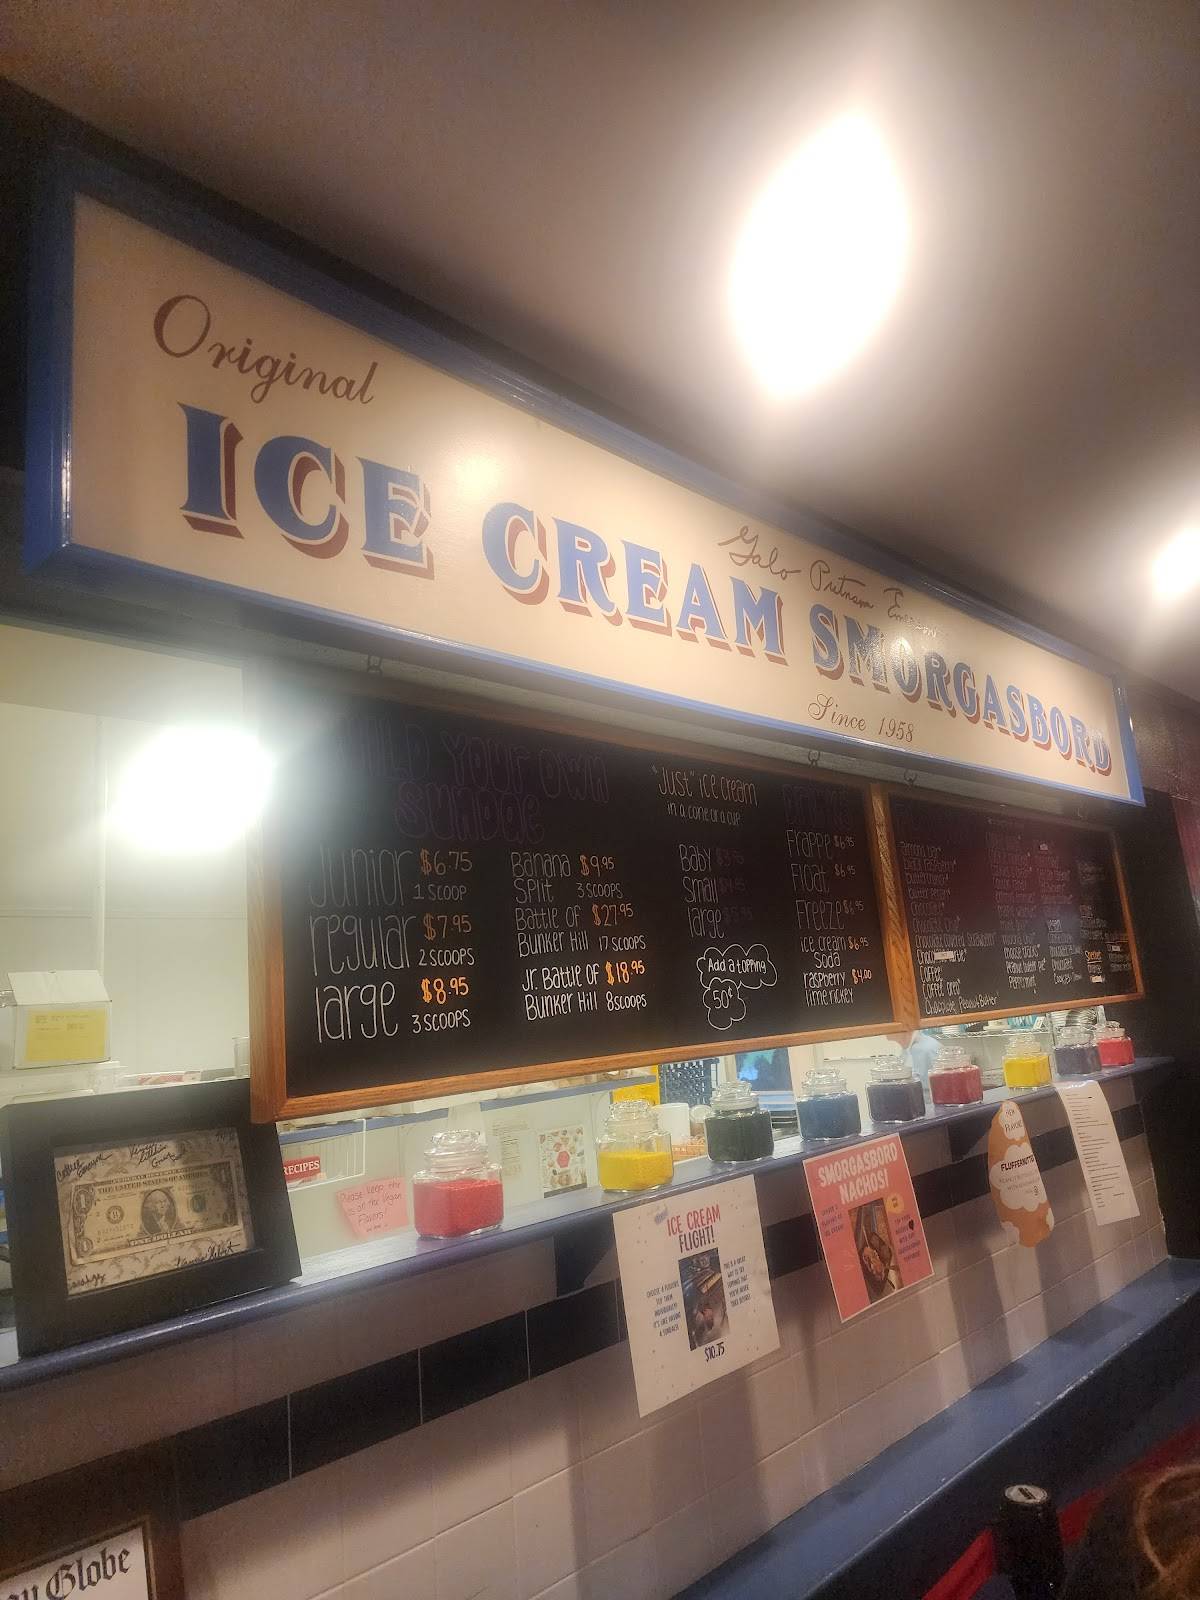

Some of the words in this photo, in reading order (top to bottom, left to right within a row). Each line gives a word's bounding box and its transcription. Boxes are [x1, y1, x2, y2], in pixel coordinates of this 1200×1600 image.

[153, 294, 378, 404] Original
[177, 401, 436, 580] ICE
[482, 501, 789, 666] CREAM
[808, 603, 1112, 777] SMORGASBORD
[807, 693, 867, 732] Since
[877, 716, 915, 743] 1958
[700, 774, 719, 799] ice
[720, 776, 759, 807] cream
[678, 844, 712, 873] Baby
[785, 829, 832, 859] Frappe
[419, 847, 473, 876] $6.75
[510, 851, 572, 879] Banana
[579, 855, 615, 876] $9.95
[682, 876, 719, 904] Small
[791, 863, 830, 893] Float
[515, 906, 559, 932] Battle
[592, 903, 634, 928] $27.95
[687, 907, 725, 939] large
[795, 900, 846, 931] Freeze
[309, 914, 417, 976] regular
[423, 913, 473, 942] $7.95
[518, 932, 566, 958] Bunker
[570, 929, 589, 952] Hill
[800, 936, 815, 952] ice
[818, 936, 847, 952] cream
[847, 935, 869, 951] $6.95
[707, 957, 726, 972] Add
[813, 951, 841, 969] Soda
[521, 967, 539, 992] Jr.
[541, 964, 583, 991] Battle
[605, 960, 645, 986] $18.95
[851, 968, 872, 985] $4.00
[314, 980, 400, 1043] large
[421, 976, 469, 1004] $8.95
[524, 993, 574, 1021] Bunker
[577, 990, 599, 1013] Hill
[805, 989, 828, 1008] lime
[283, 1160, 320, 1176] RECIPES
[818, 1142, 898, 1188] SMORGASBORD
[839, 1168, 889, 1205] NACHOS!
[667, 1214, 682, 1238] ICE
[686, 1203, 721, 1231] CREAM
[678, 1224, 716, 1254] FLIGHT!
[704, 1341, 726, 1363] $10.75
[45, 1546, 130, 1600] Globe
